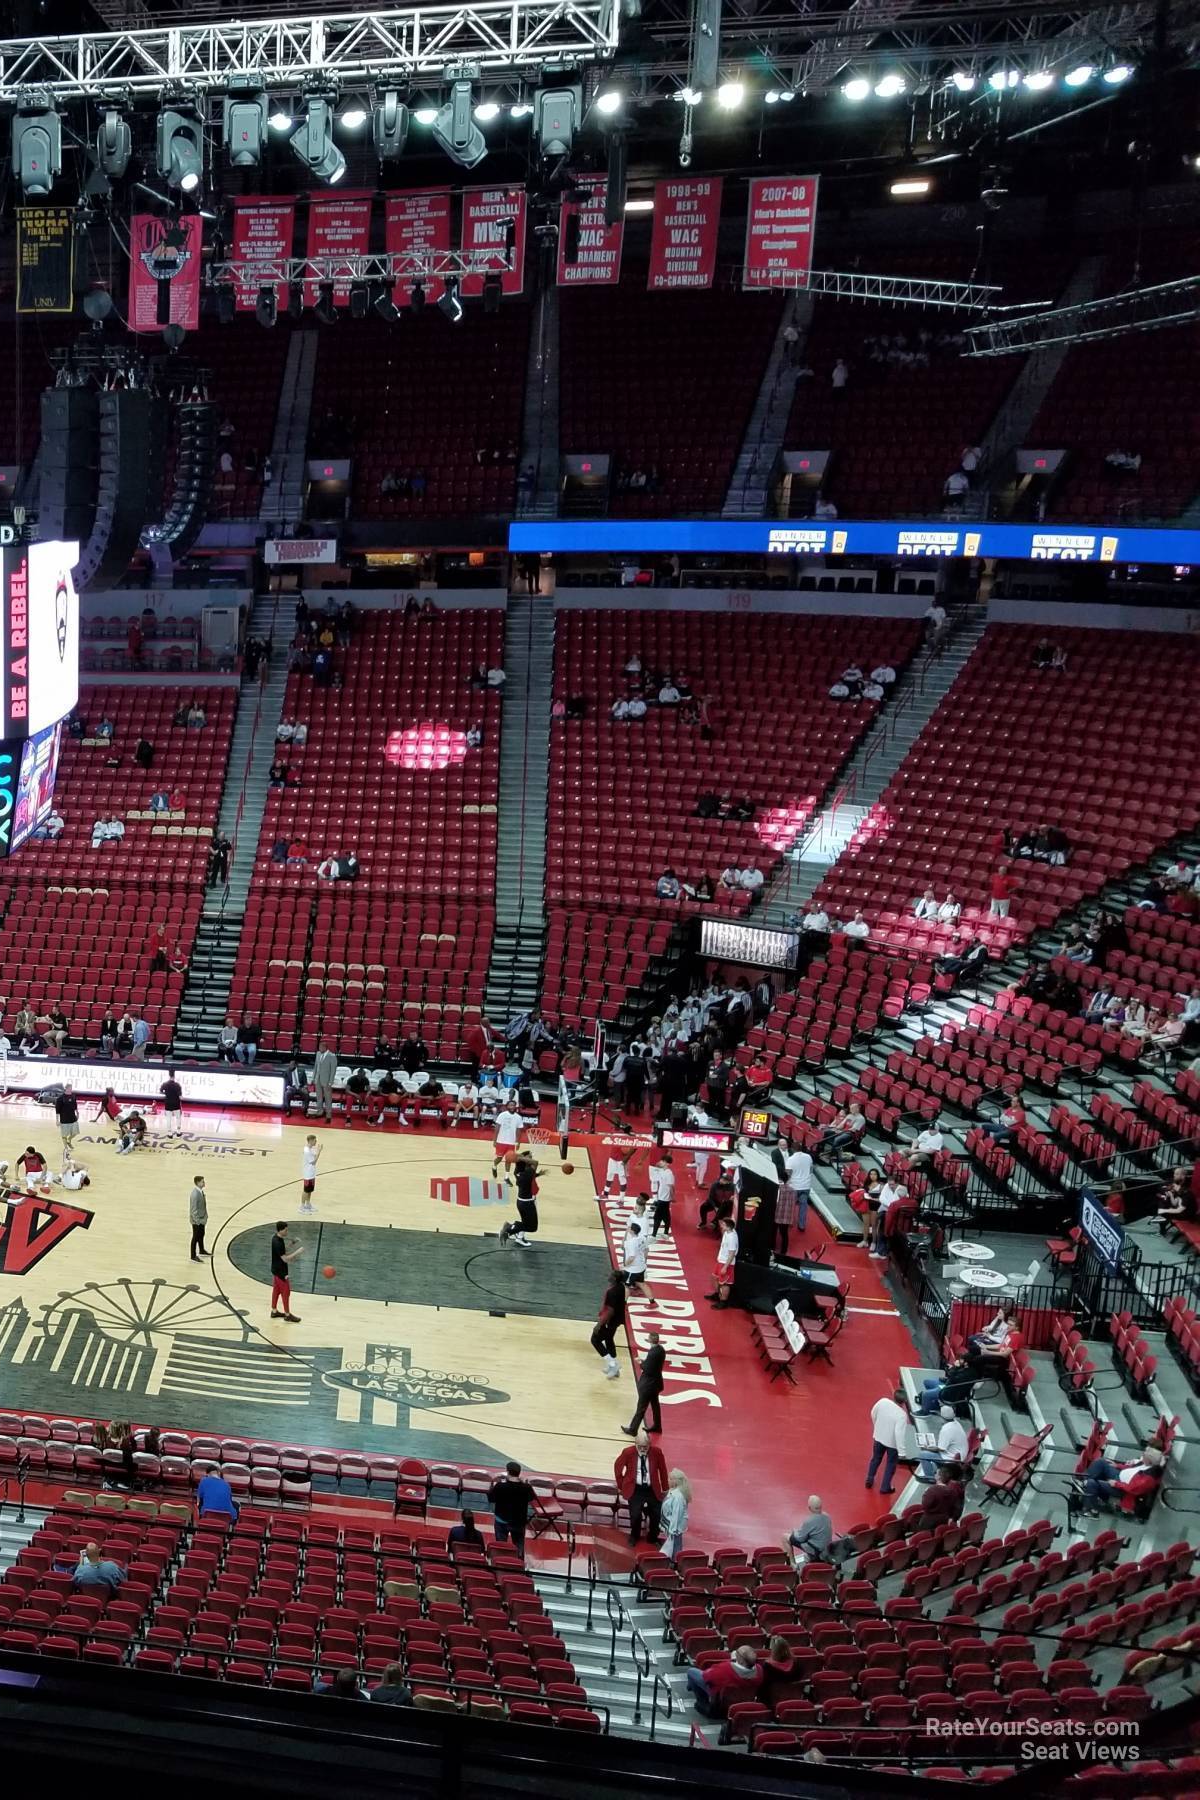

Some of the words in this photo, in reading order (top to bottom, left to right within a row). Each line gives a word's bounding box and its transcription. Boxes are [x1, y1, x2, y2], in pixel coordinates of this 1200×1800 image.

[761, 186, 806, 201] 2007-08
[581, 197, 606, 209] EN'S
[676, 200, 697, 212] MEN'S
[469, 204, 520, 217] BASKETBALL
[22, 210, 69, 227] NCAA
[664, 214, 706, 226] BASKETBALL
[27, 228, 47, 236] FINAL
[579, 229, 604, 247] WAC
[671, 229, 700, 244] WAC
[577, 251, 616, 263] RNAMENT
[664, 247, 702, 258] MOUNTAIN
[667, 261, 698, 272] DIVISION
[768, 258, 788, 267] NCAA
[565, 266, 612, 280] CHAMPIONS
[654, 274, 708, 286] CO-CHAMPIONS
[11, 559, 27, 648] REBEL.
[728, 592, 751, 608] 119
[11, 655, 27, 678] A
[11, 685, 27, 718] BE
[41, 1065, 96, 1079] OFFICIAL
[101, 1069, 154, 1083] CHICKEN
[746, 1122, 762, 1133] 30
[77, 1135, 191, 1151] AMRICA
[198, 1144, 275, 1157] FIRST
[673, 1132, 718, 1148] Smith's
[347, 1363, 488, 1384] WELCOME
[352, 1378, 398, 1391] LAS
[405, 1384, 487, 1401] VEGAS
[386, 1392, 447, 1403] NEVADA
